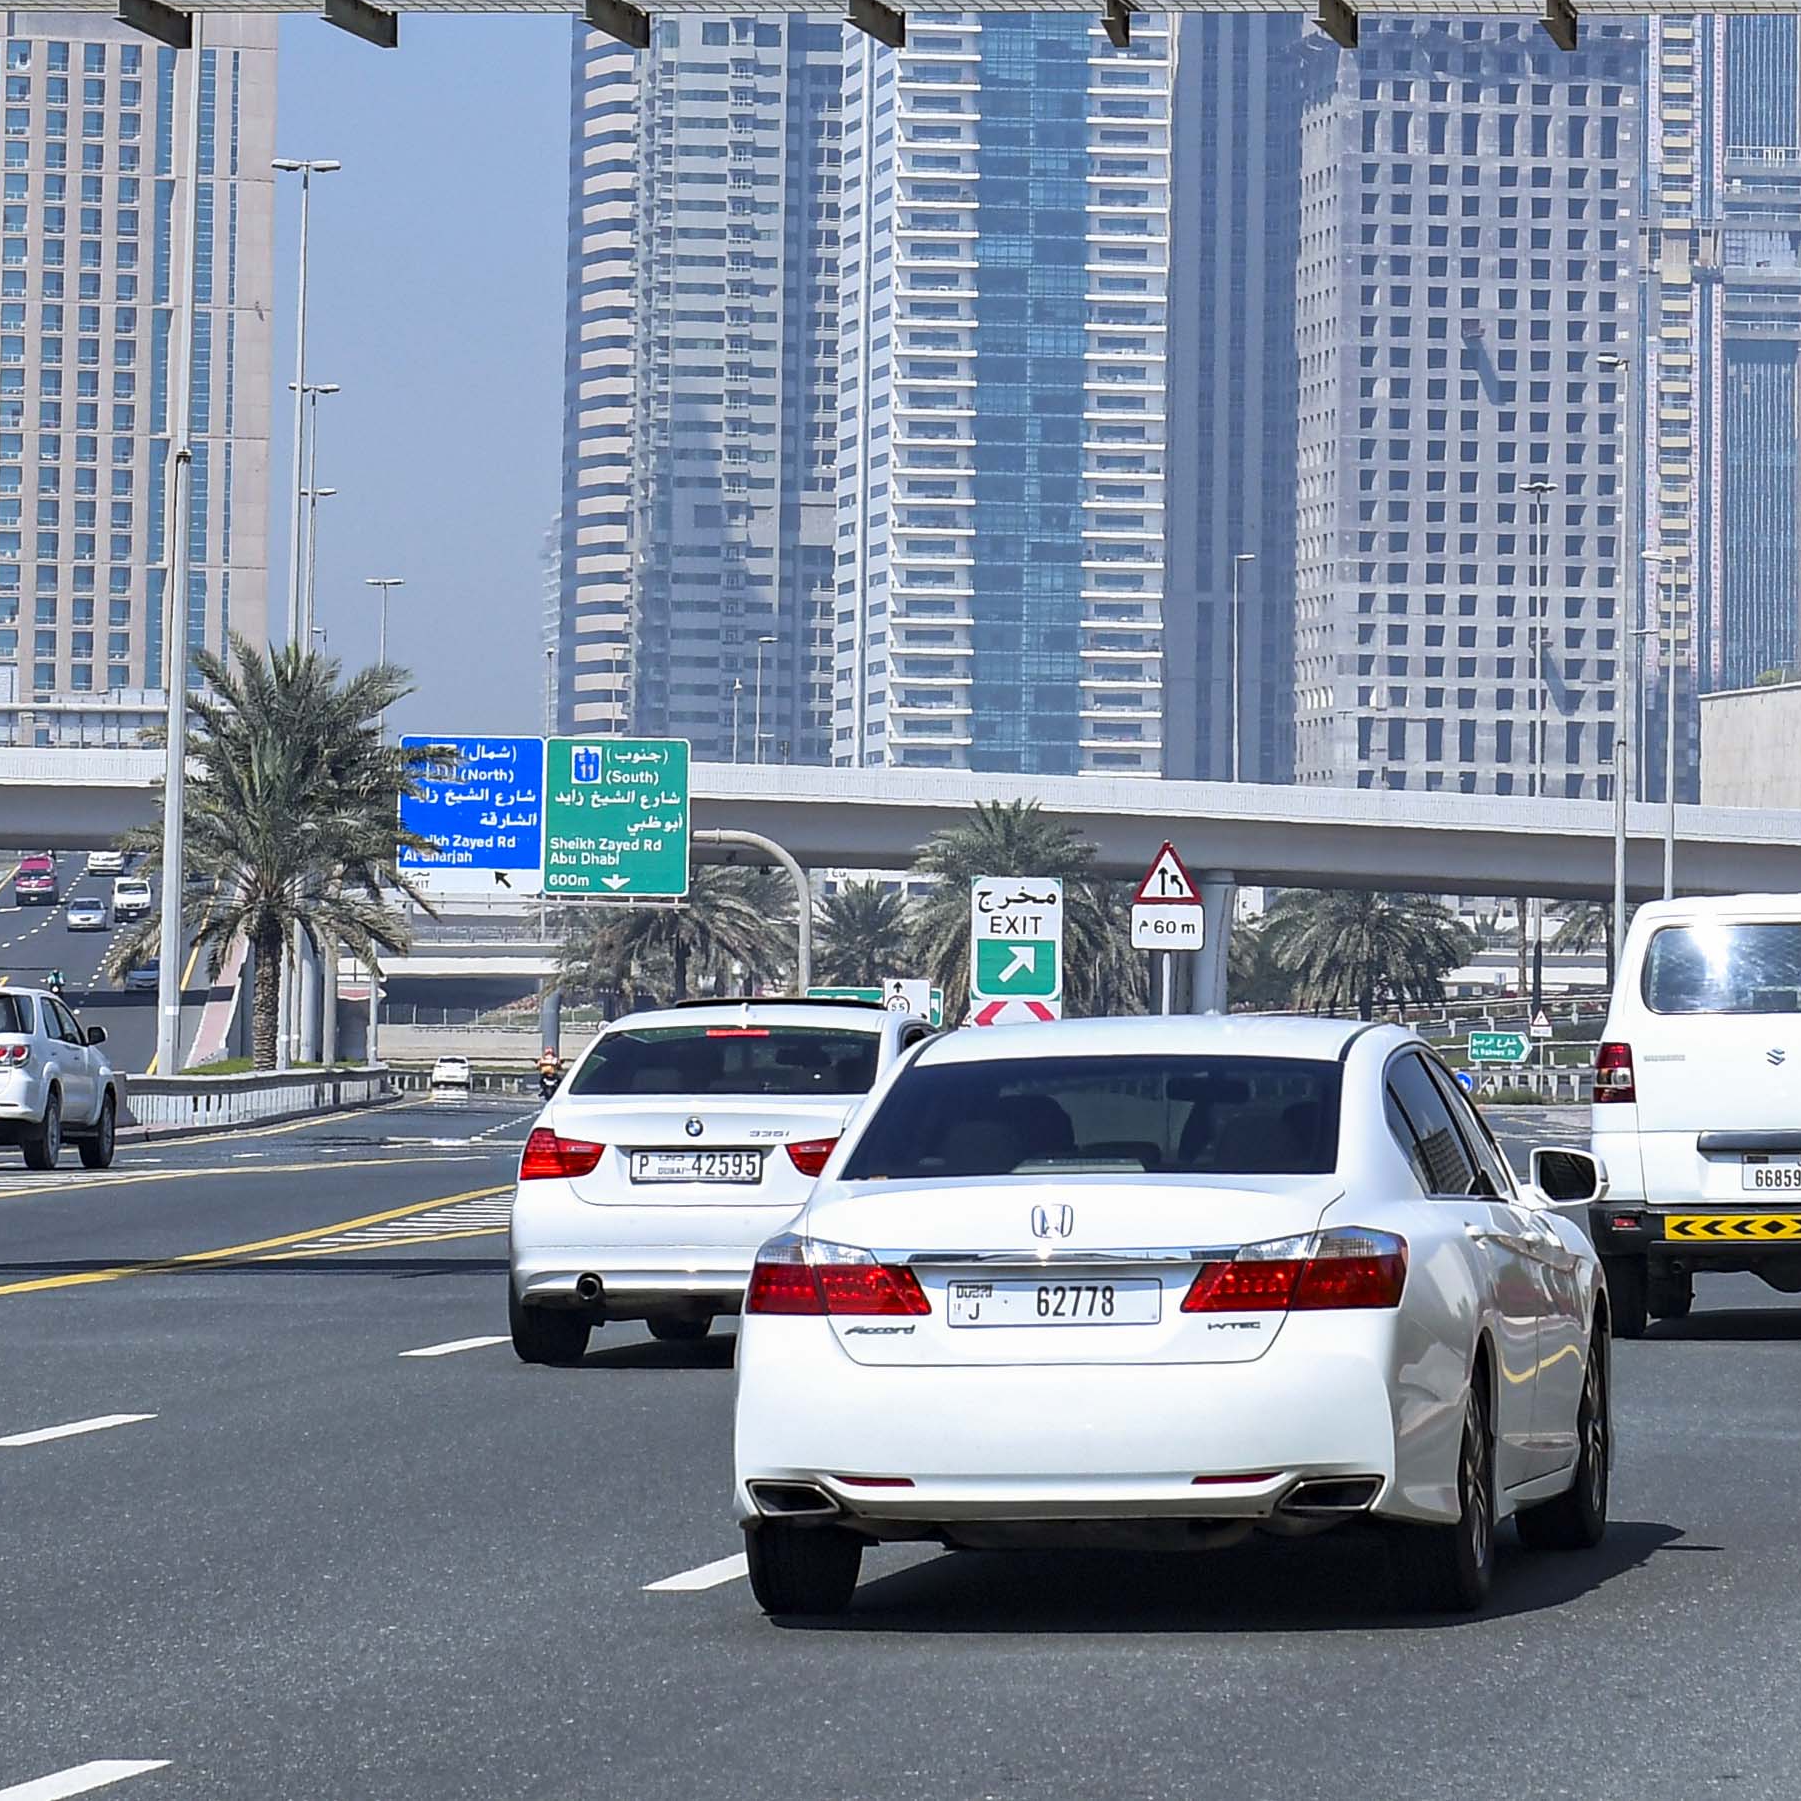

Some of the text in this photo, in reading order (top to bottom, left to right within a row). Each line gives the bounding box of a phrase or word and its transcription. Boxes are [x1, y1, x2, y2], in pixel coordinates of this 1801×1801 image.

[461, 768, 515, 784] (North)
[606, 770, 660, 785] (South)
[555, 788, 681, 810] شارع الشيخ زايد
[479, 811, 538, 829] الشارقة
[452, 834, 494, 850] Zayed
[497, 835, 517, 848] Rd
[549, 837, 662, 852] Sheikh Zayed Rd
[549, 851, 620, 866] Abu Dhabi
[548, 874, 590, 886] 600m
[978, 886, 1057, 911] مخرج
[990, 916, 1043, 935] EXIT
[1154, 921, 1177, 934] 60
[639, 1154, 757, 1176] P 42595
[1755, 1169, 1801, 1187] 66859
[1036, 1285, 1115, 1318] 62778
[968, 1302, 980, 1320] J
[844, 1324, 916, 1336] Accord
